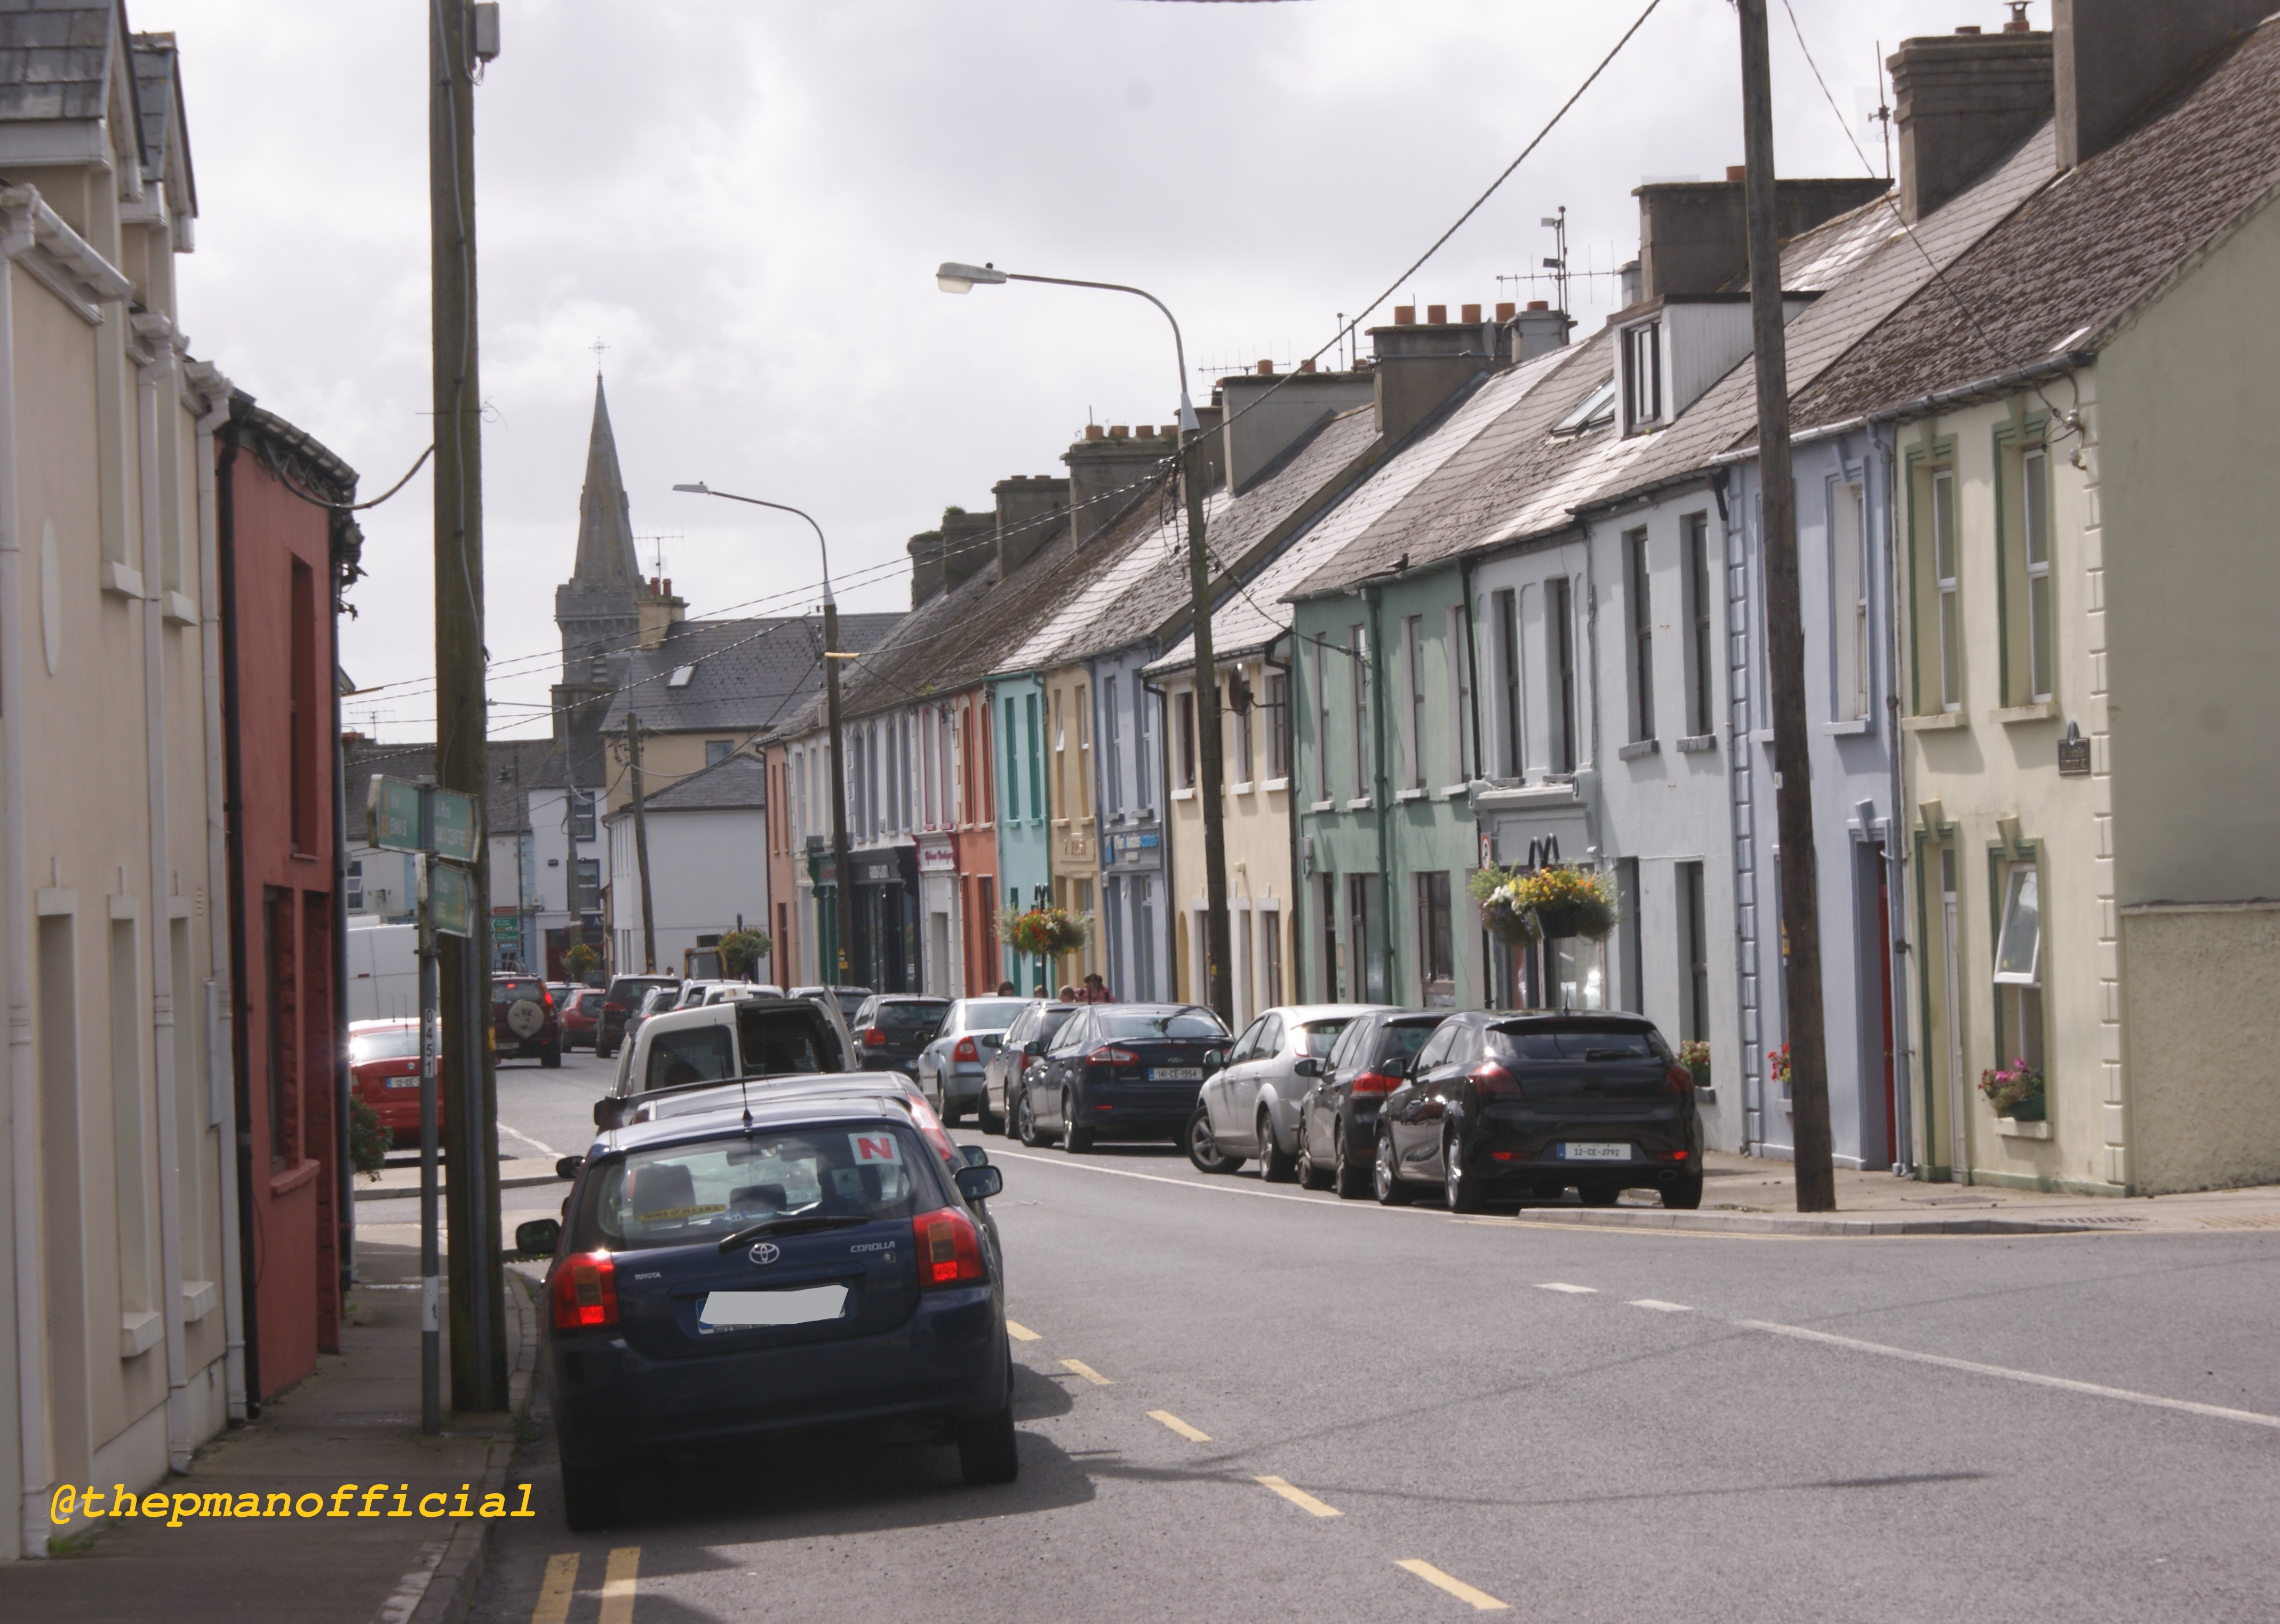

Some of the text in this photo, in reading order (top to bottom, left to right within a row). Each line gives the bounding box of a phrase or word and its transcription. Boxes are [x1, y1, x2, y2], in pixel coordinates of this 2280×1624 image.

[1158, 1069, 1198, 1077] 141-CE-1954
[857, 1137, 894, 1160] N
[1574, 1148, 1620, 1157] 12-CE-3792
[850, 1241, 896, 1253] COROLLA
[634, 1272, 661, 1280] TOYOTA
